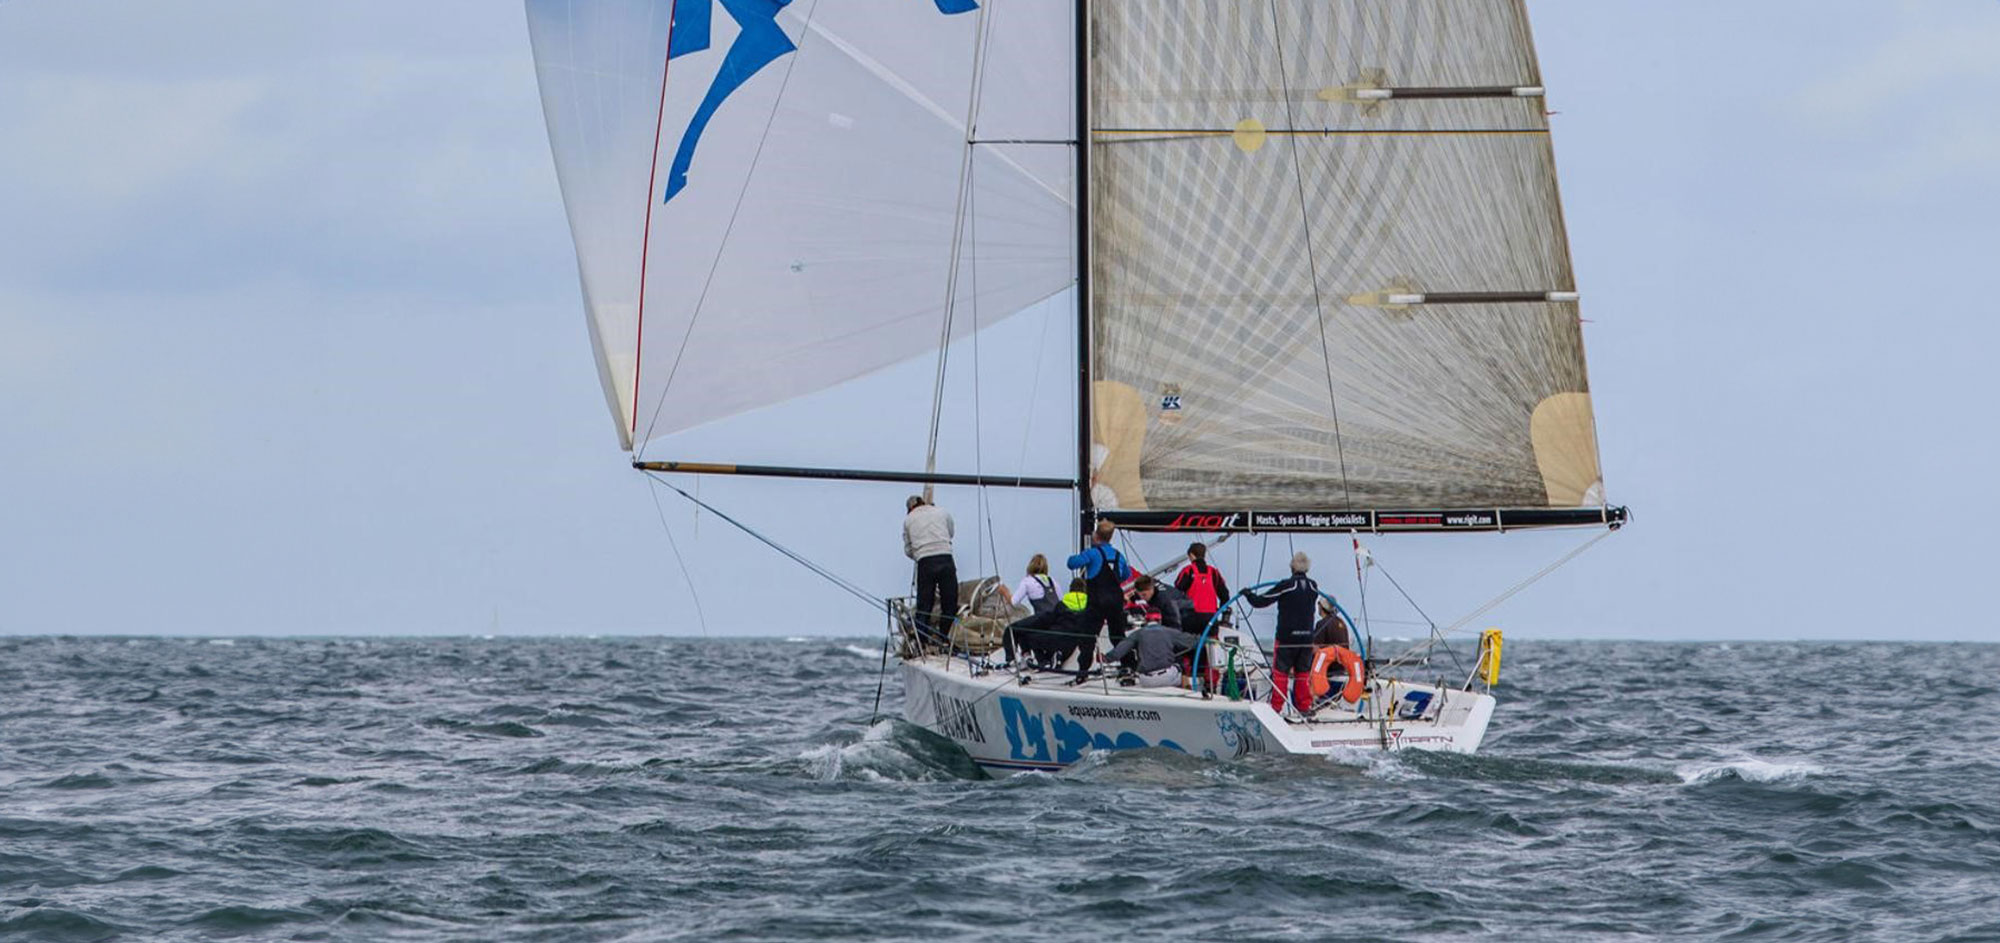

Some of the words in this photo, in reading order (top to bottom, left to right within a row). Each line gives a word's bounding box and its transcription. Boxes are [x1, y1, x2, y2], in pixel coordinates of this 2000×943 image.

[1256, 515, 1278, 525] Masts,
[1279, 515, 1297, 527] Spars
[1298, 515, 1304, 524] &
[1305, 515, 1330, 527] Rigging
[1331, 515, 1366, 527] Specialists
[1068, 705, 1161, 721] aquapaxwater.com
